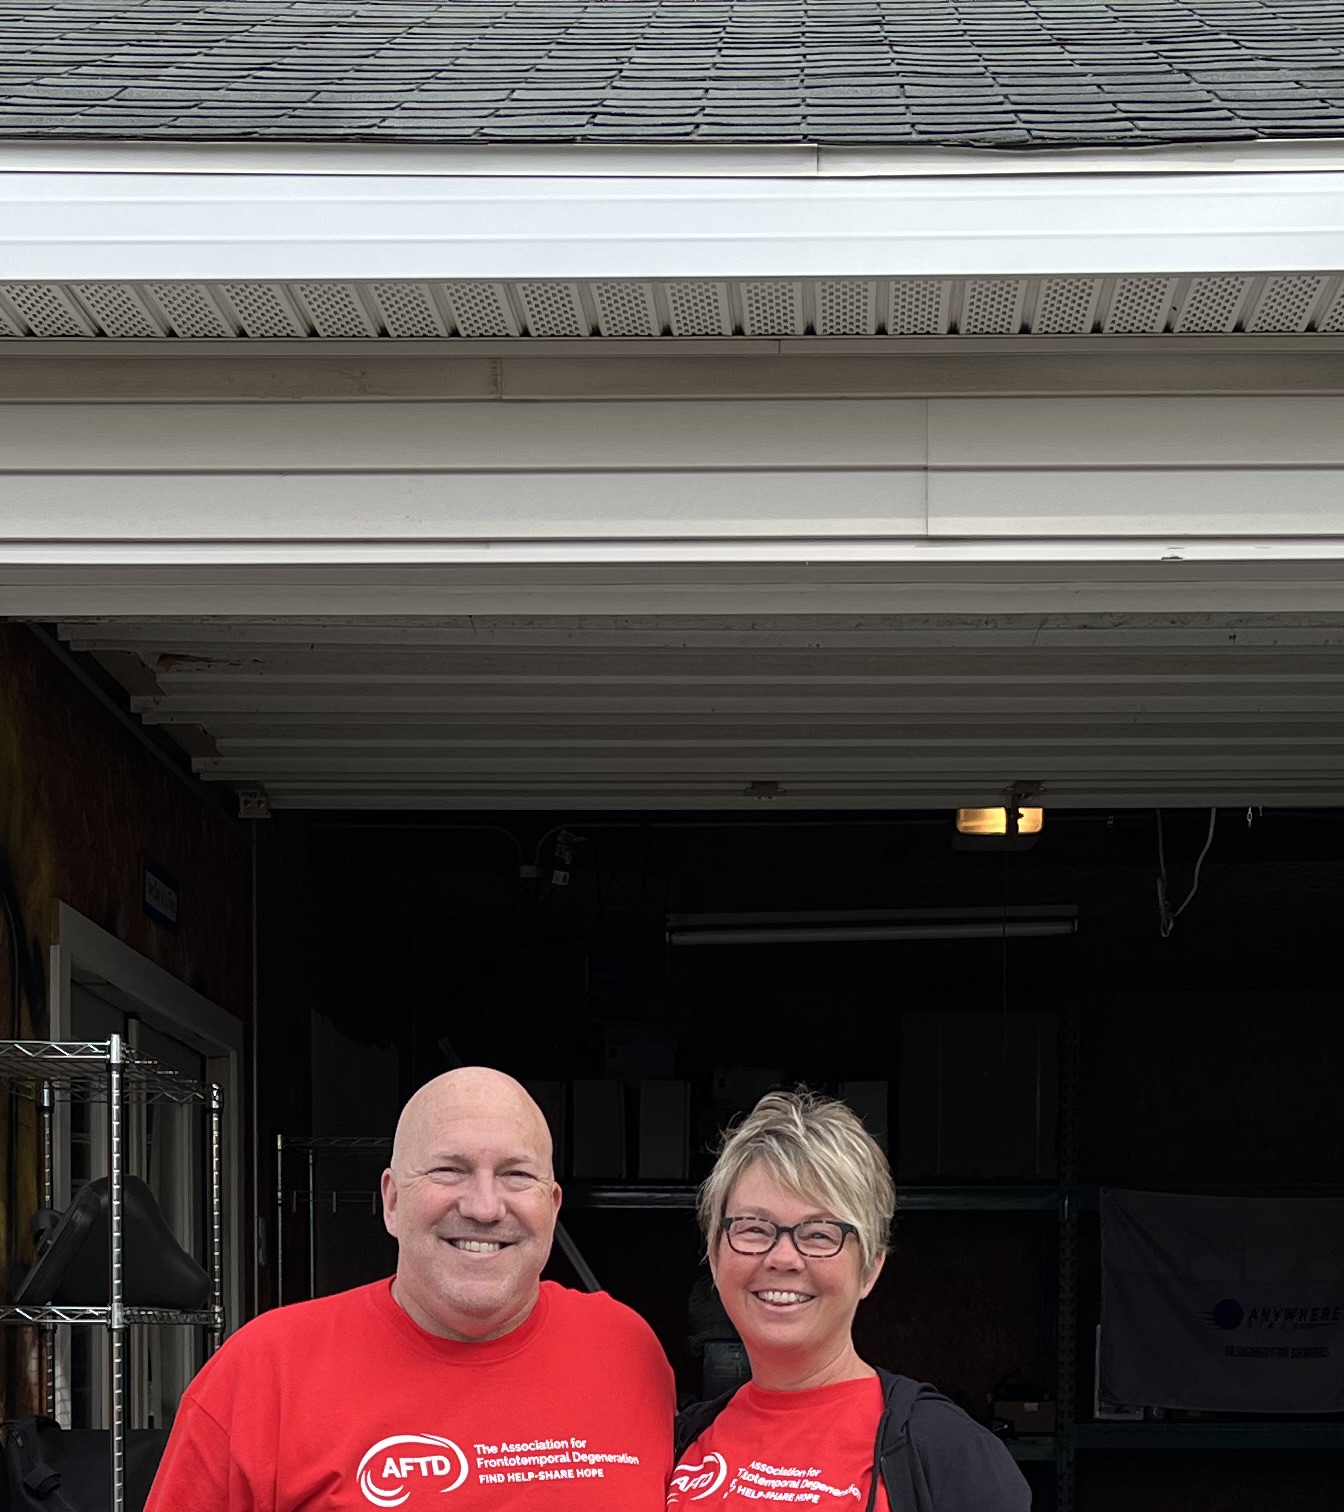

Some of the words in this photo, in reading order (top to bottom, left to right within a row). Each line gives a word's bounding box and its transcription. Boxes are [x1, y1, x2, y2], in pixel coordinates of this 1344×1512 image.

[1248, 1306, 1343, 1322] ANYWHERE
[473, 1443, 498, 1455] The
[501, 1439, 569, 1453] Association
[570, 1437, 587, 1449] for
[382, 1455, 451, 1478] AFTD
[476, 1452, 571, 1469] Frontotemporal
[572, 1451, 640, 1465] Degeneration
[479, 1473, 505, 1484] FIND
[576, 1468, 605, 1478] HOPE
[806, 1467, 822, 1477] for
